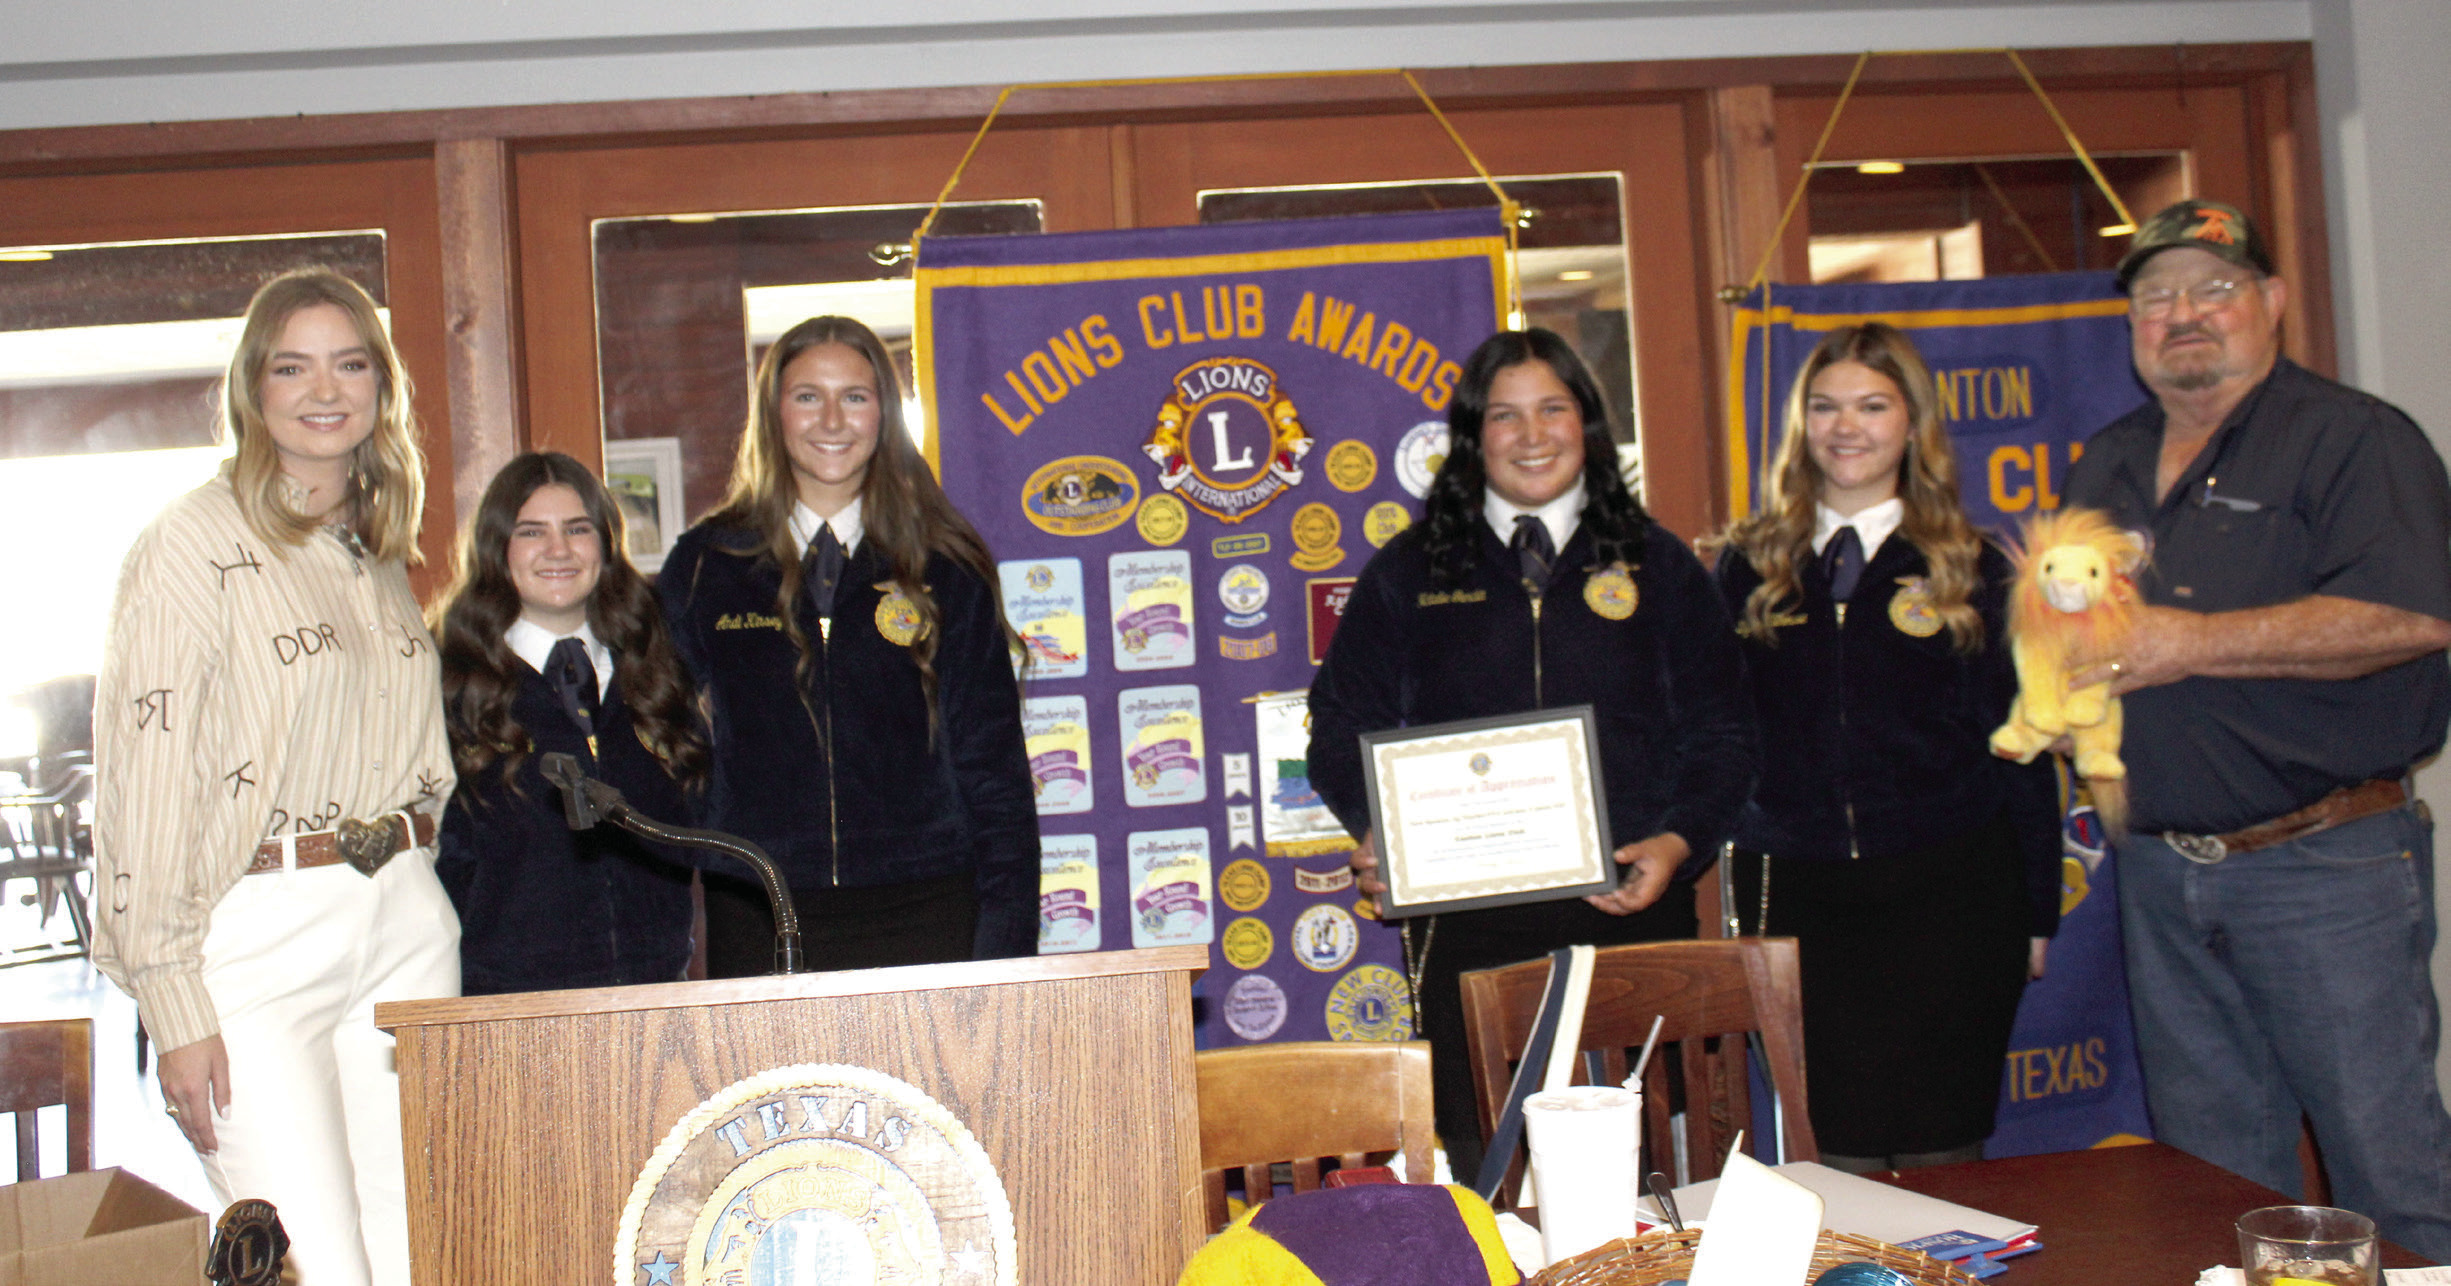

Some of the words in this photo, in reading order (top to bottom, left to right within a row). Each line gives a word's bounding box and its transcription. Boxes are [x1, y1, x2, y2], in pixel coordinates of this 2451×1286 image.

[981, 314, 1124, 436] LIONS
[1138, 284, 1265, 349] CLUB
[1287, 291, 1463, 411] AWARDS
[1181, 365, 1270, 401] LIONS
[1207, 410, 1254, 471] L
[1180, 473, 1283, 508] INTERNATIONAL
[1988, 442, 2084, 513] CL
[272, 623, 343, 666] DDR
[1330, 972, 1362, 1014] NEW
[2006, 1036, 2108, 1101] TEXAS
[714, 1095, 913, 1159] TEXAS
[759, 1177, 866, 1214] LIONS
[239, 1235, 265, 1279] L
